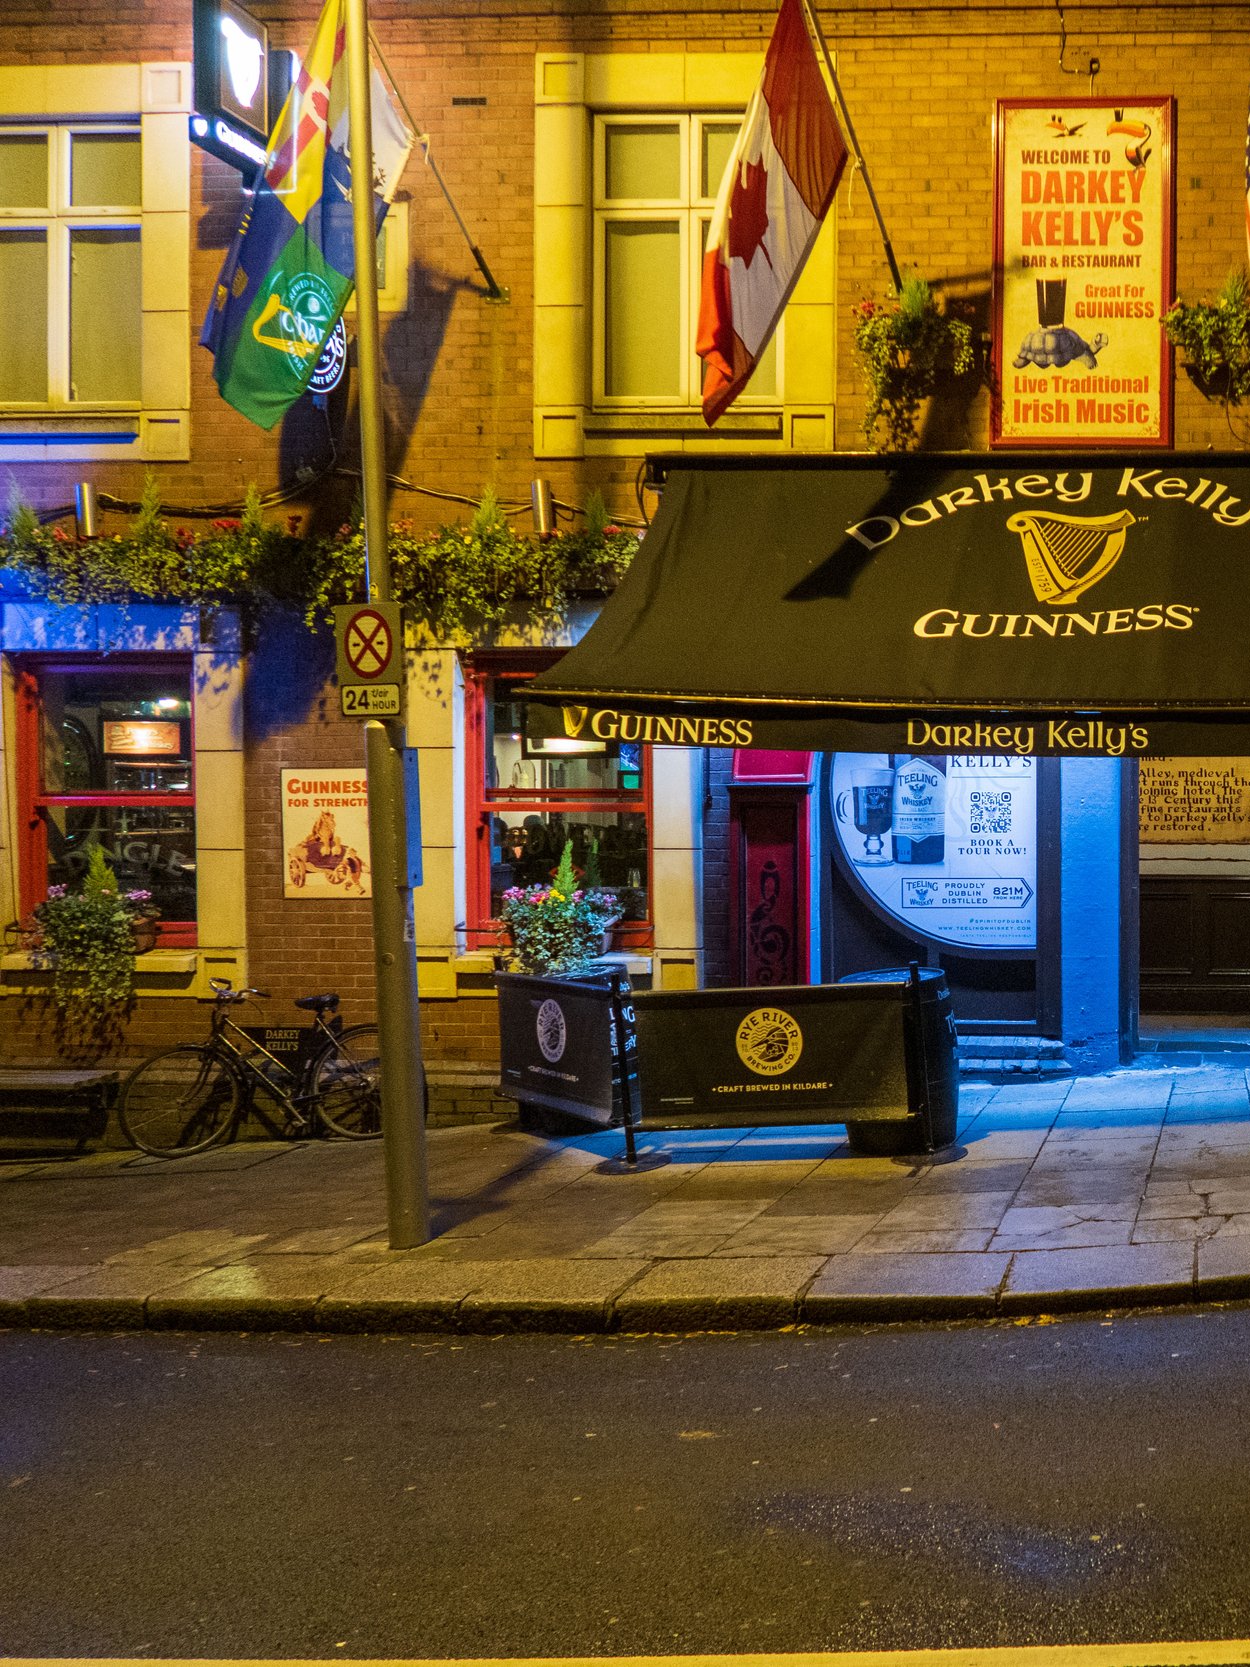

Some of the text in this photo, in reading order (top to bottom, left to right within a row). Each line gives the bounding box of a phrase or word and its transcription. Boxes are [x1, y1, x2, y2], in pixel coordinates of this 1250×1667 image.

[1021, 149, 1111, 165] WELCOME TO
[1020, 170, 1147, 204] DARKEY
[1021, 210, 1144, 247] KELLY'S
[1021, 254, 1142, 269] BAR & RESTAURANT
[1084, 284, 1146, 298] Great For
[1074, 301, 1155, 319] GUINNESS
[1014, 375, 1149, 394] Live Traditional
[1013, 398, 1150, 425] Irish Music
[845, 471, 1094, 550] Darkey
[1035, 573, 1053, 593] 1759
[913, 604, 1195, 638] GUINNESS
[345, 689, 370, 711] 24
[372, 700, 397, 710] HOUR
[591, 709, 753, 746] GUINNESS
[907, 718, 1149, 756] Darkey Kelly's
[950, 755, 1033, 768] KELLY'S
[1139, 767, 1236, 779] Alley, medieval
[897, 772, 938, 787] TEELING
[1184, 777, 1230, 789] through
[1183, 786, 1216, 796] hotel
[288, 798, 309, 808] FOR
[901, 796, 933, 807] WHISKEY
[1164, 795, 1212, 805] Century
[1217, 795, 1241, 805] this
[1141, 804, 1241, 813] fine restaurants
[1148, 813, 1161, 822] to
[1164, 812, 1208, 822] Darkey
[970, 839, 1015, 847] BOOK A
[958, 847, 1028, 855] TOUR NOW!
[905, 880, 939, 892] TEELING
[992, 886, 1024, 896] 821M
[909, 898, 934, 906] WHISKEY
[941, 897, 989, 905] DISTILLED
[739, 1011, 799, 1040] RYE RIVER
[265, 1029, 301, 1039] DARKEY
[266, 1041, 299, 1051] KELLY'S
[746, 1055, 784, 1072] BREWING
[717, 1081, 828, 1093] CRAFT BREWED IN KILDARE
